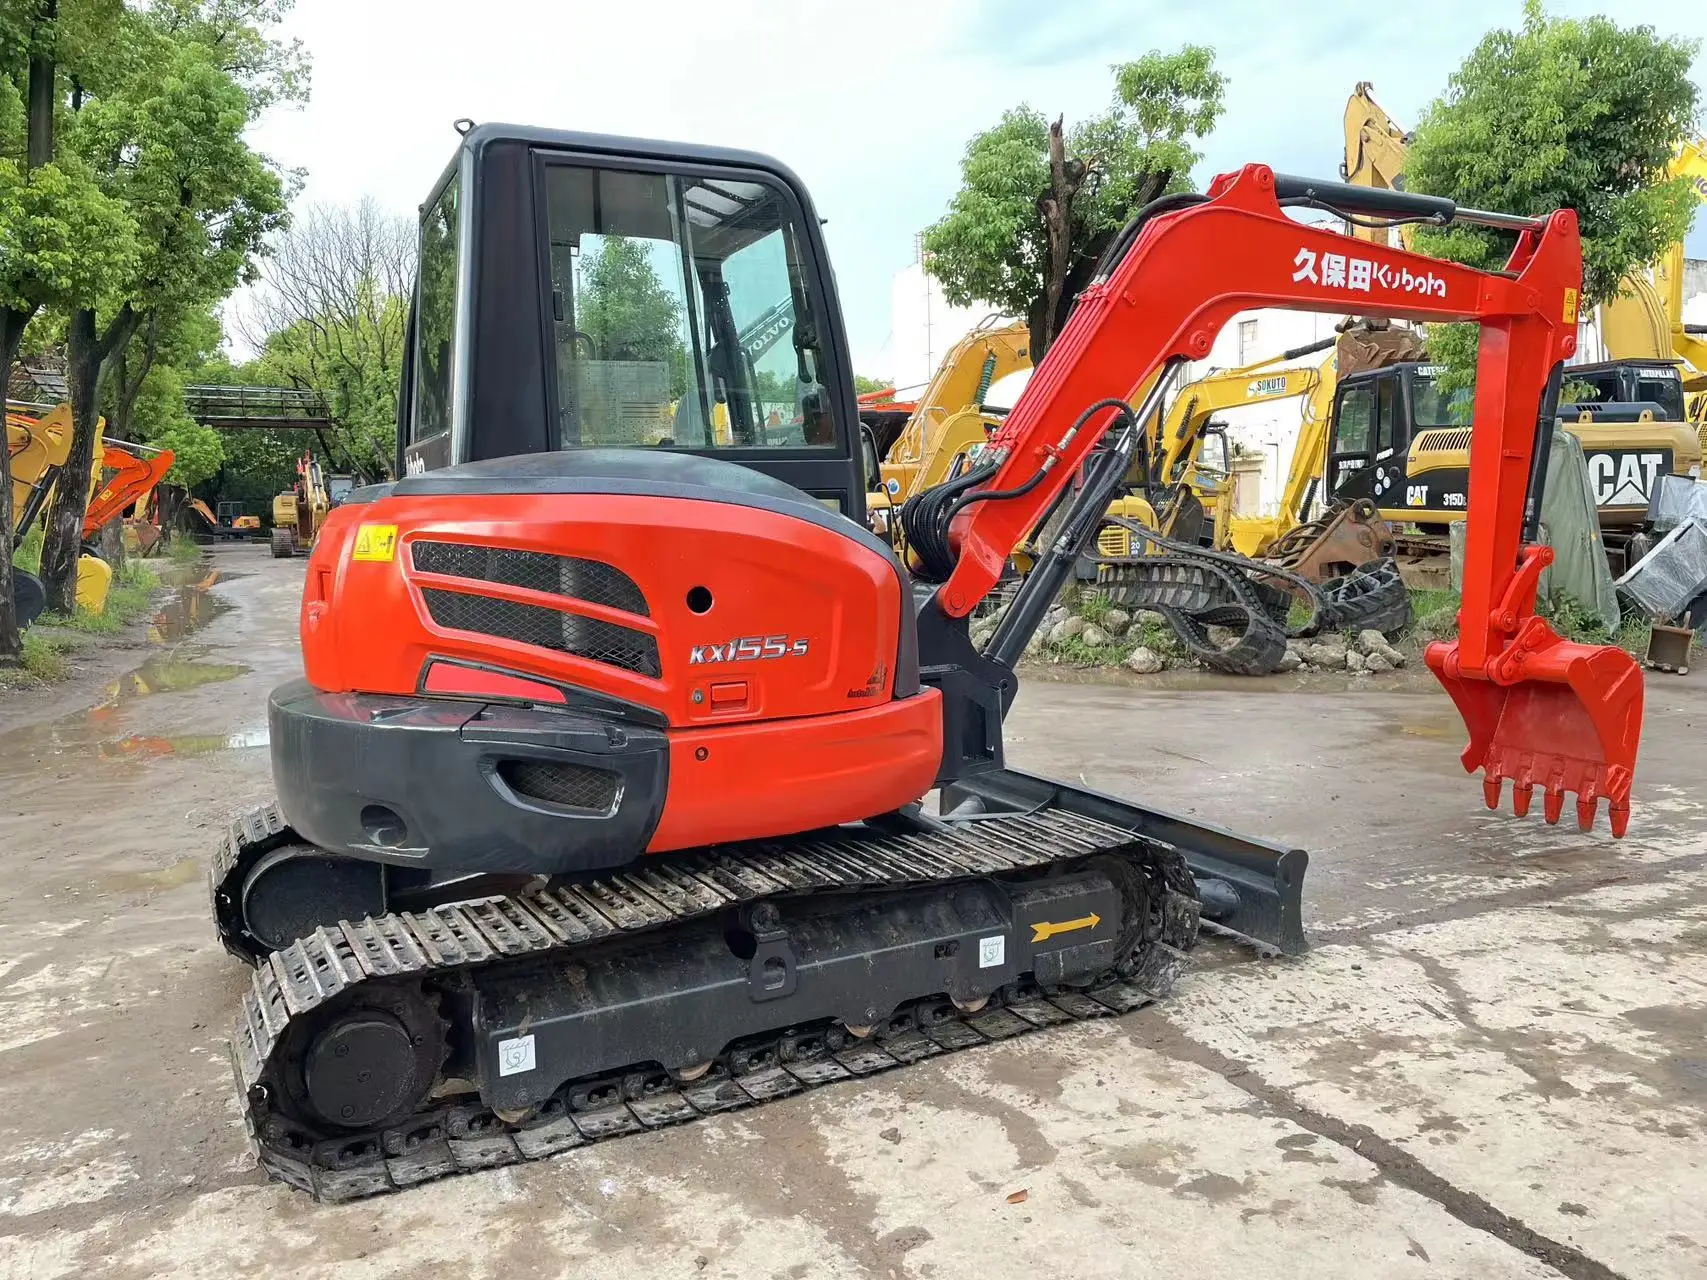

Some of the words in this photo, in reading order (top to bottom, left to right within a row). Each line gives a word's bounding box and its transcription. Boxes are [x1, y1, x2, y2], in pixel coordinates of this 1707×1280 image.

[1292, 247, 1372, 293] 久保田
[1373, 261, 1446, 298] Kubota
[1257, 376, 1286, 391] SOKUTO
[1588, 453, 1663, 505] CAT
[1406, 486, 1428, 506] CAT
[689, 634, 809, 665] KX155-5
